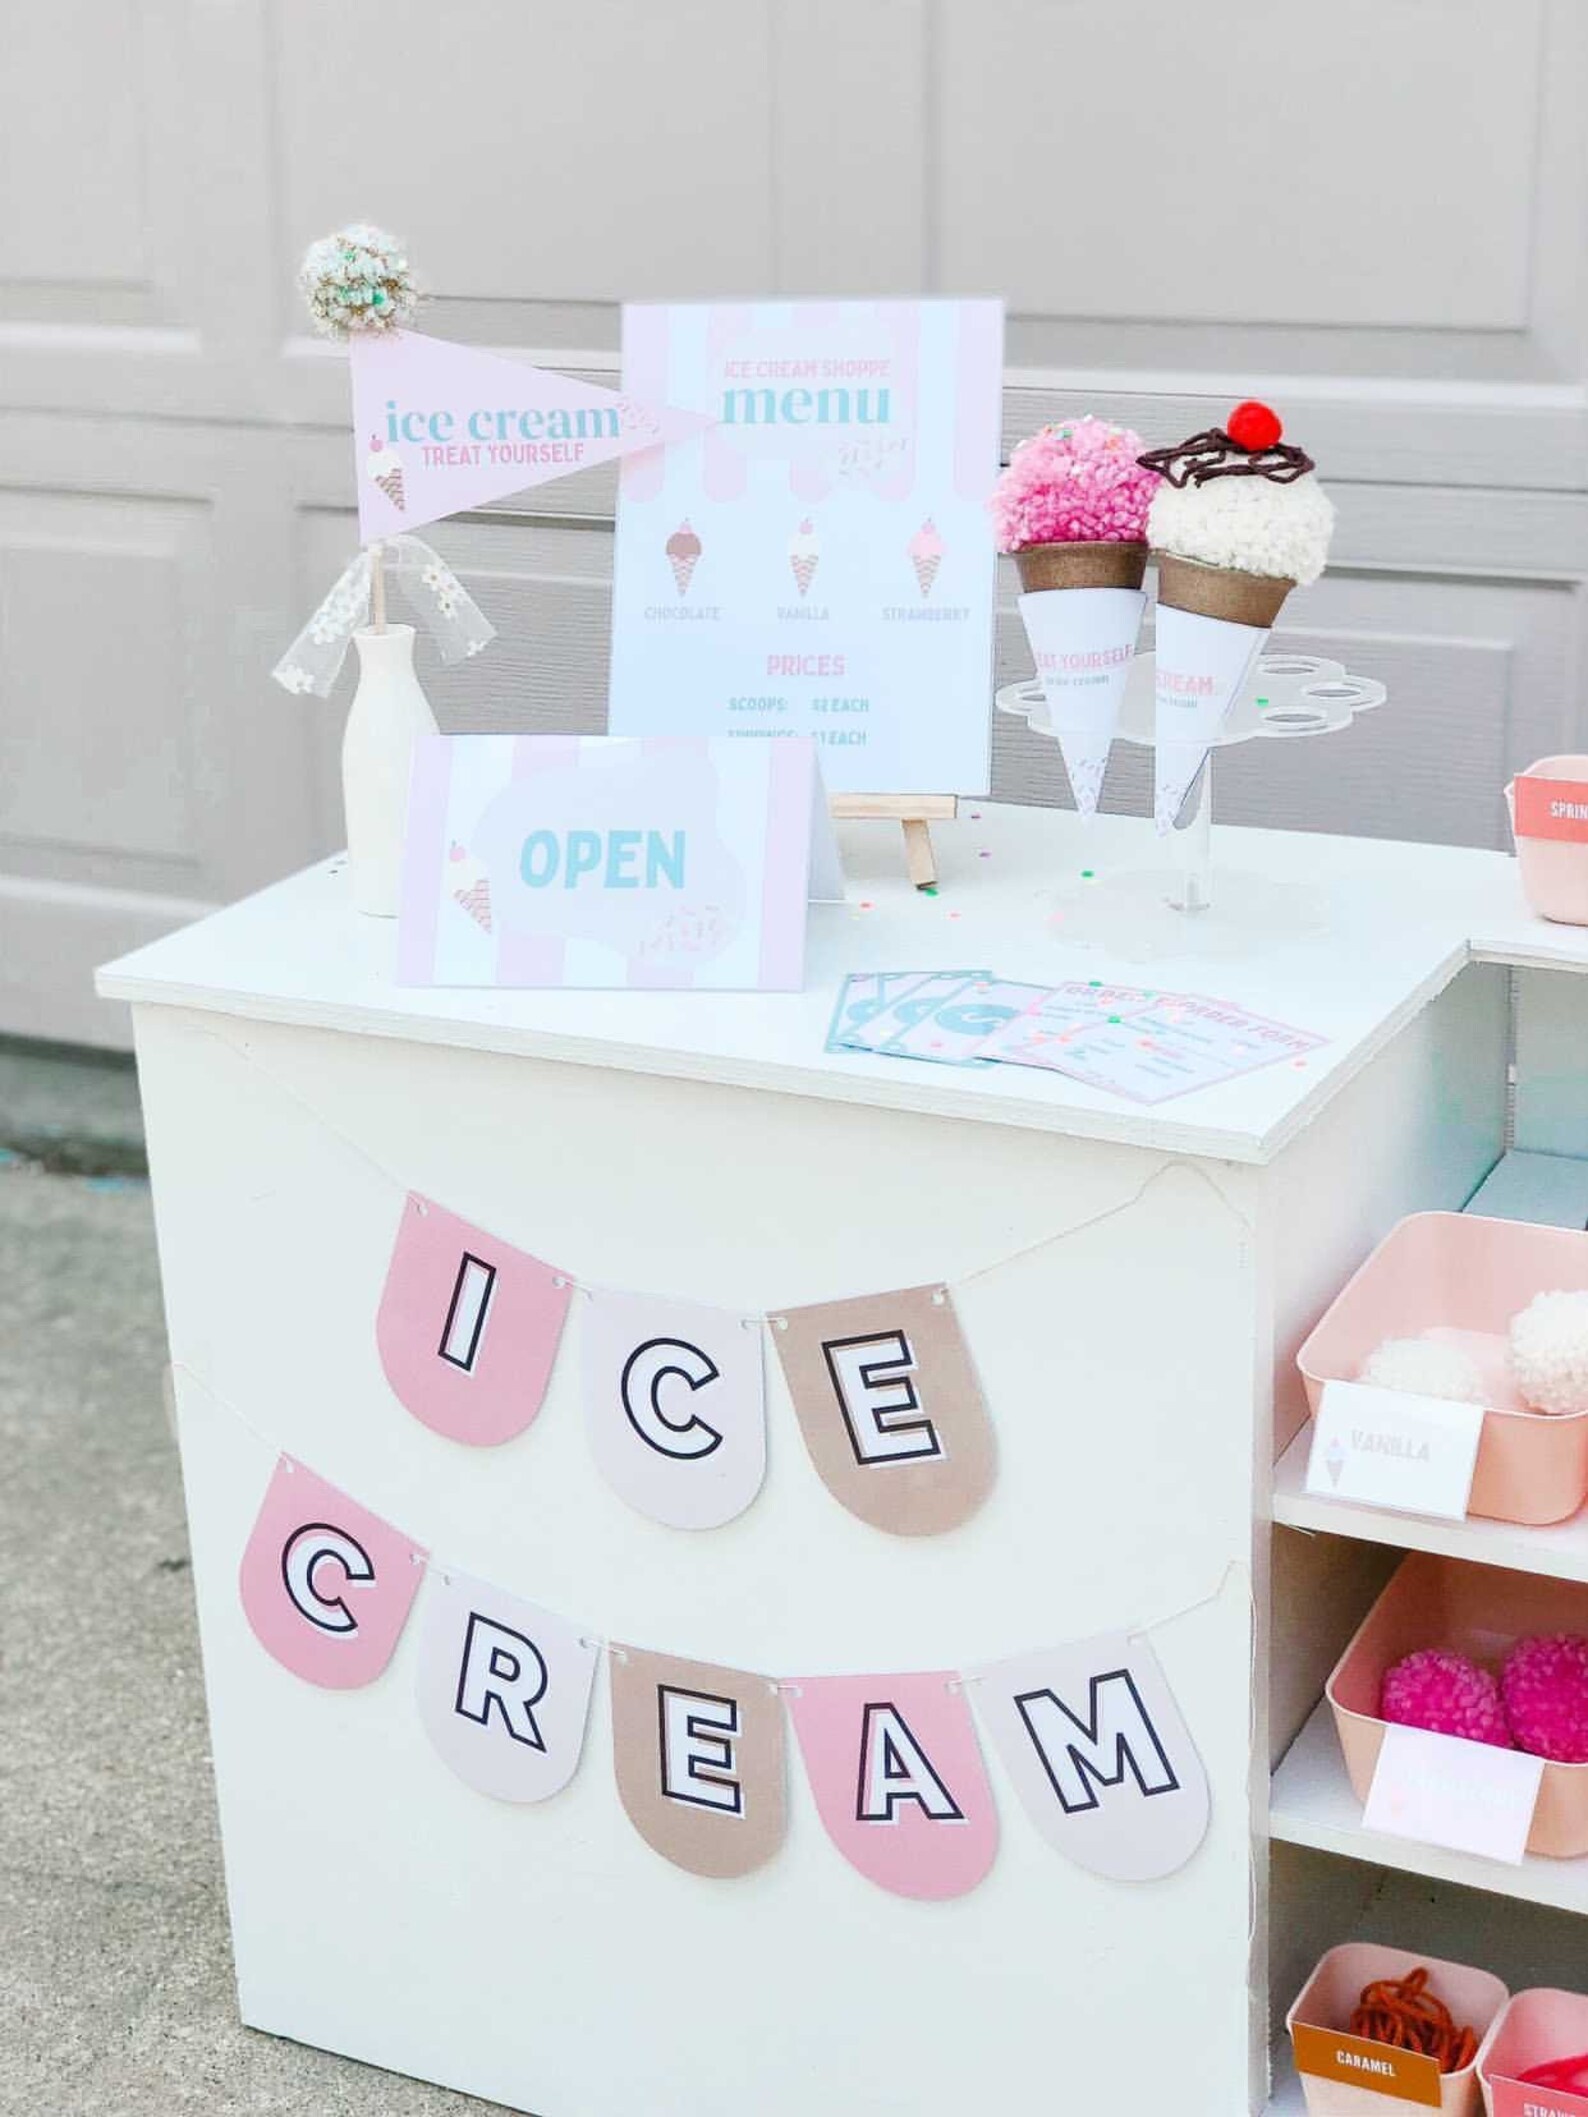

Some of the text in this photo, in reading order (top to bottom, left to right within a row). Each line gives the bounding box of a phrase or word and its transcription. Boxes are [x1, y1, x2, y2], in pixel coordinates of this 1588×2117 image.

[724, 358, 891, 378] ICE CREAM SHOPPE
[719, 387, 891, 424] menu
[386, 400, 620, 442] ice cream
[422, 442, 584, 467] TREAT YOURSELF
[643, 606, 721, 621] CHOCOLATE
[776, 606, 830, 621] VANILLA
[881, 606, 971, 621] STRAWBERRY
[766, 654, 846, 677] PRICES
[1061, 643, 1134, 669] YOURSELF
[830, 696, 870, 713] EACH
[828, 730, 868, 746] EACH
[520, 829, 686, 889] OPEN
[1351, 1428, 1430, 1462] VANILLA
[1336, 2049, 1397, 2077] CARAMEL
